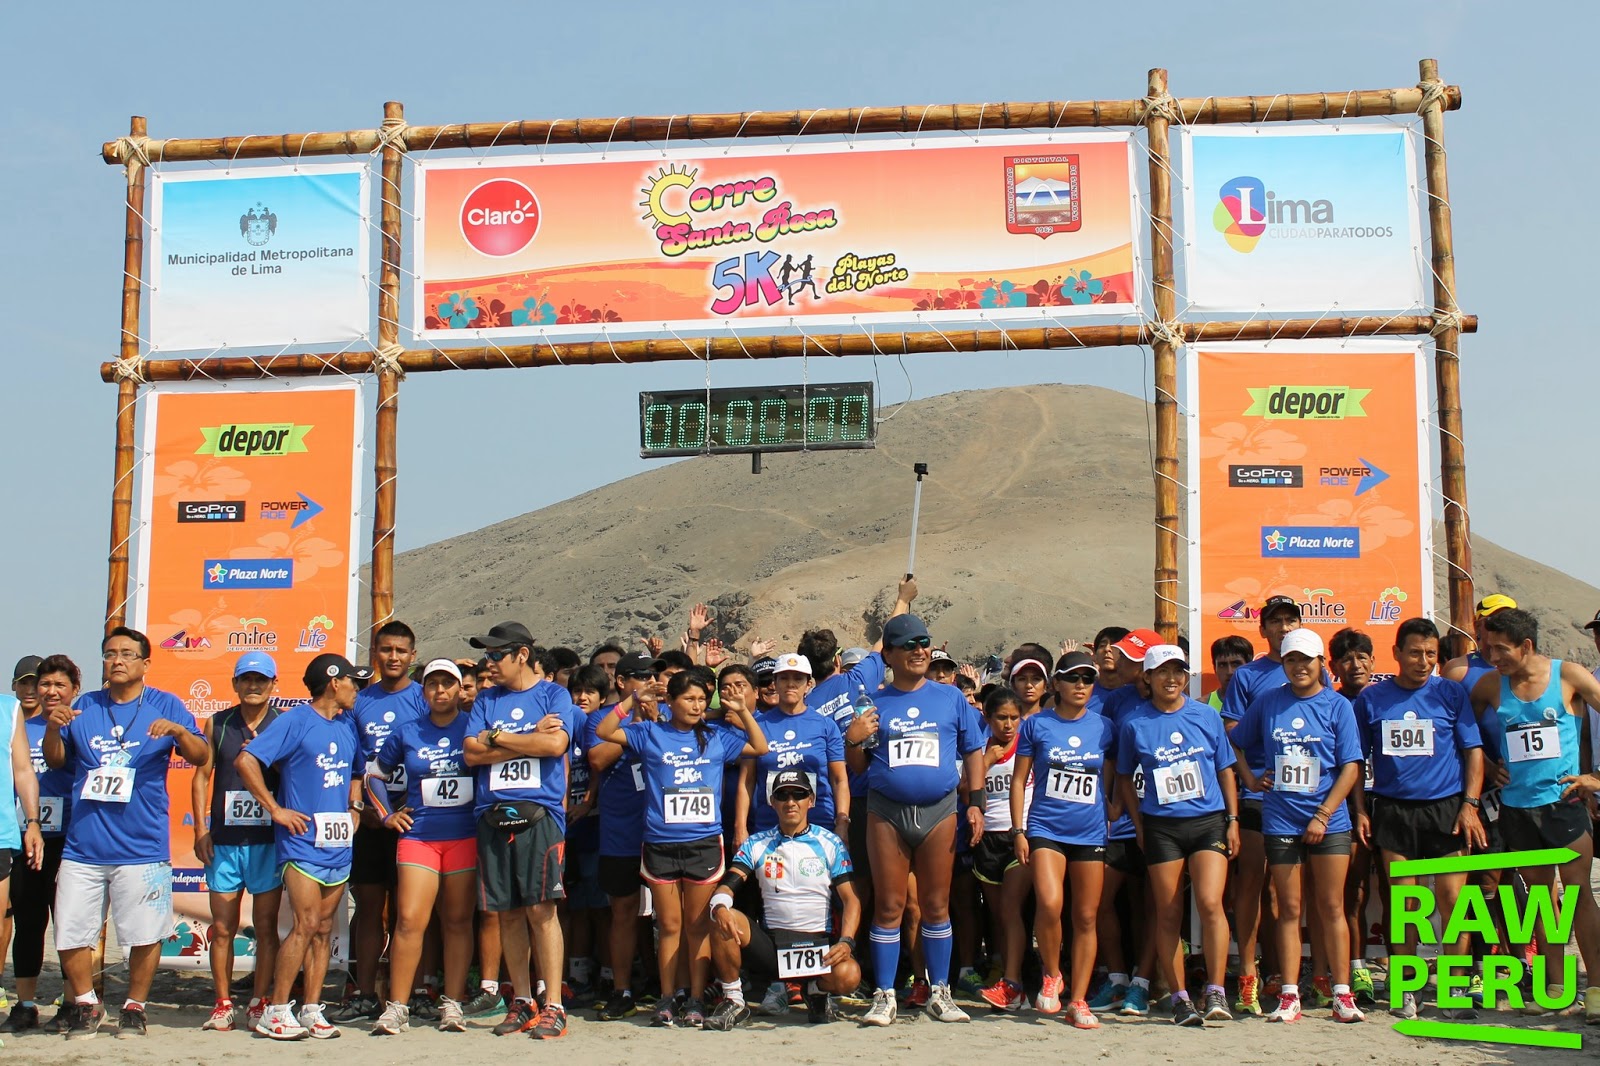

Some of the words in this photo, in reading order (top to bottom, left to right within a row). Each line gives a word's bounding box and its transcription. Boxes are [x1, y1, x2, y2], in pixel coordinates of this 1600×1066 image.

[643, 166, 776, 228] Corre
[1235, 187, 1335, 225] Lima
[467, 208, 524, 226] Claro
[657, 219, 753, 257] Santa
[756, 201, 837, 242] Rosa
[168, 252, 256, 266] Municipalidad
[260, 247, 353, 263] Metropolitana
[835, 252, 895, 276] Playas
[231, 265, 247, 276] de
[251, 263, 282, 275] Lima
[711, 249, 784, 315] 5K
[826, 272, 852, 294] del
[855, 268, 908, 292] Norte
[1268, 386, 1345, 419] depor
[645, 394, 869, 449] 00:00:00
[218, 425, 290, 456] depor
[1237, 468, 1293, 478] GoPro
[1319, 467, 1371, 477] POWER
[186, 504, 237, 514] GoPro
[261, 501, 309, 511] POWER
[1289, 536, 1320, 549] Plaza
[1323, 536, 1354, 549] Norte
[229, 568, 257, 580] Plaza
[260, 568, 288, 579] Norte
[1370, 600, 1402, 621] Life
[228, 626, 277, 646] mitre
[299, 628, 327, 648] Life
[1390, 729, 1425, 748] 594
[1520, 730, 1544, 753] 15
[894, 740, 935, 760] 1772
[500, 760, 531, 782] 430
[674, 767, 695, 785] 5K
[1281, 765, 1310, 785] 611
[91, 775, 124, 795] 372
[437, 779, 459, 799] 42
[1053, 772, 1093, 797] 1716
[1165, 772, 1196, 795] 610
[233, 800, 264, 819] 523
[670, 796, 711, 816] 1749
[324, 822, 349, 841] 503
[782, 949, 824, 970] 1781
